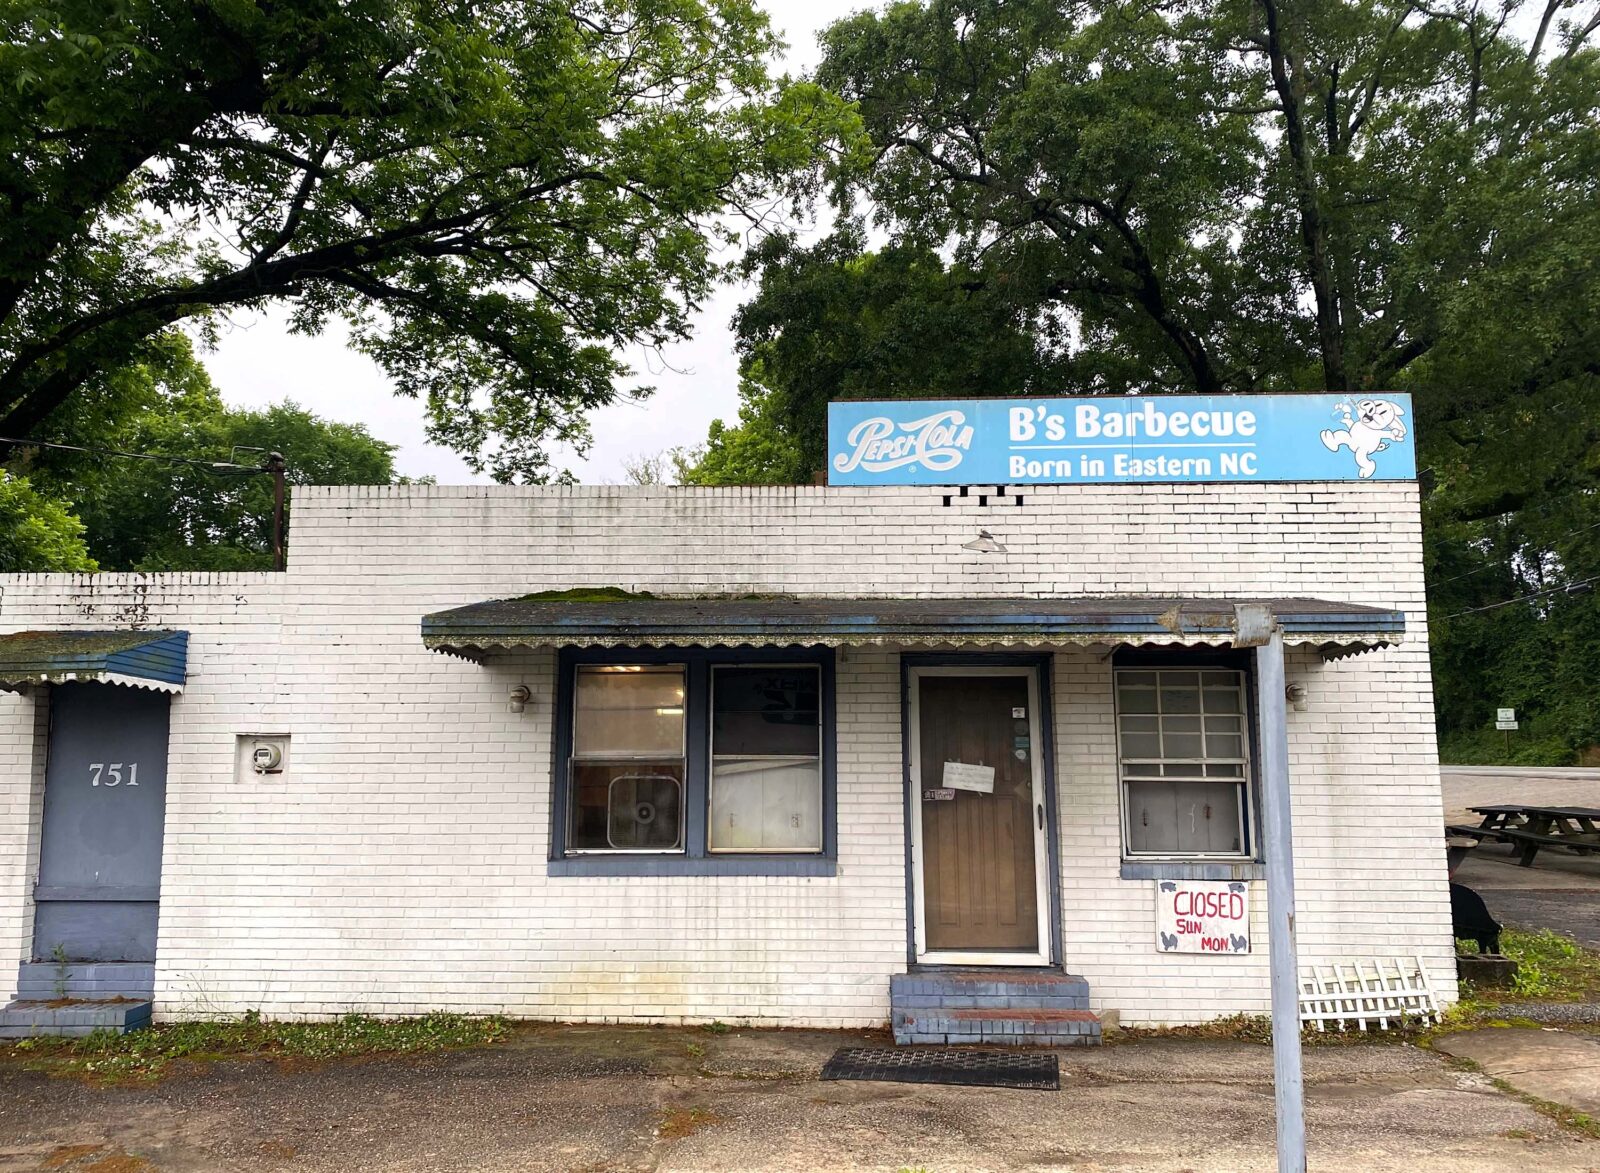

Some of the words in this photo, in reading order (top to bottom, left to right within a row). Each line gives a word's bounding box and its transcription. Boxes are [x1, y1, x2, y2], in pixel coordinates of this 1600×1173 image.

[1009, 406, 1066, 441] B's
[1075, 402, 1257, 438] Barbecue
[1009, 455, 1071, 478] Born
[1080, 455, 1105, 477] in
[1114, 453, 1211, 477] Eastern
[1220, 452, 1258, 476] NC
[89, 762, 139, 787] 751
[1176, 918, 1205, 935] SUN.
[1200, 936, 1232, 952] MON.
